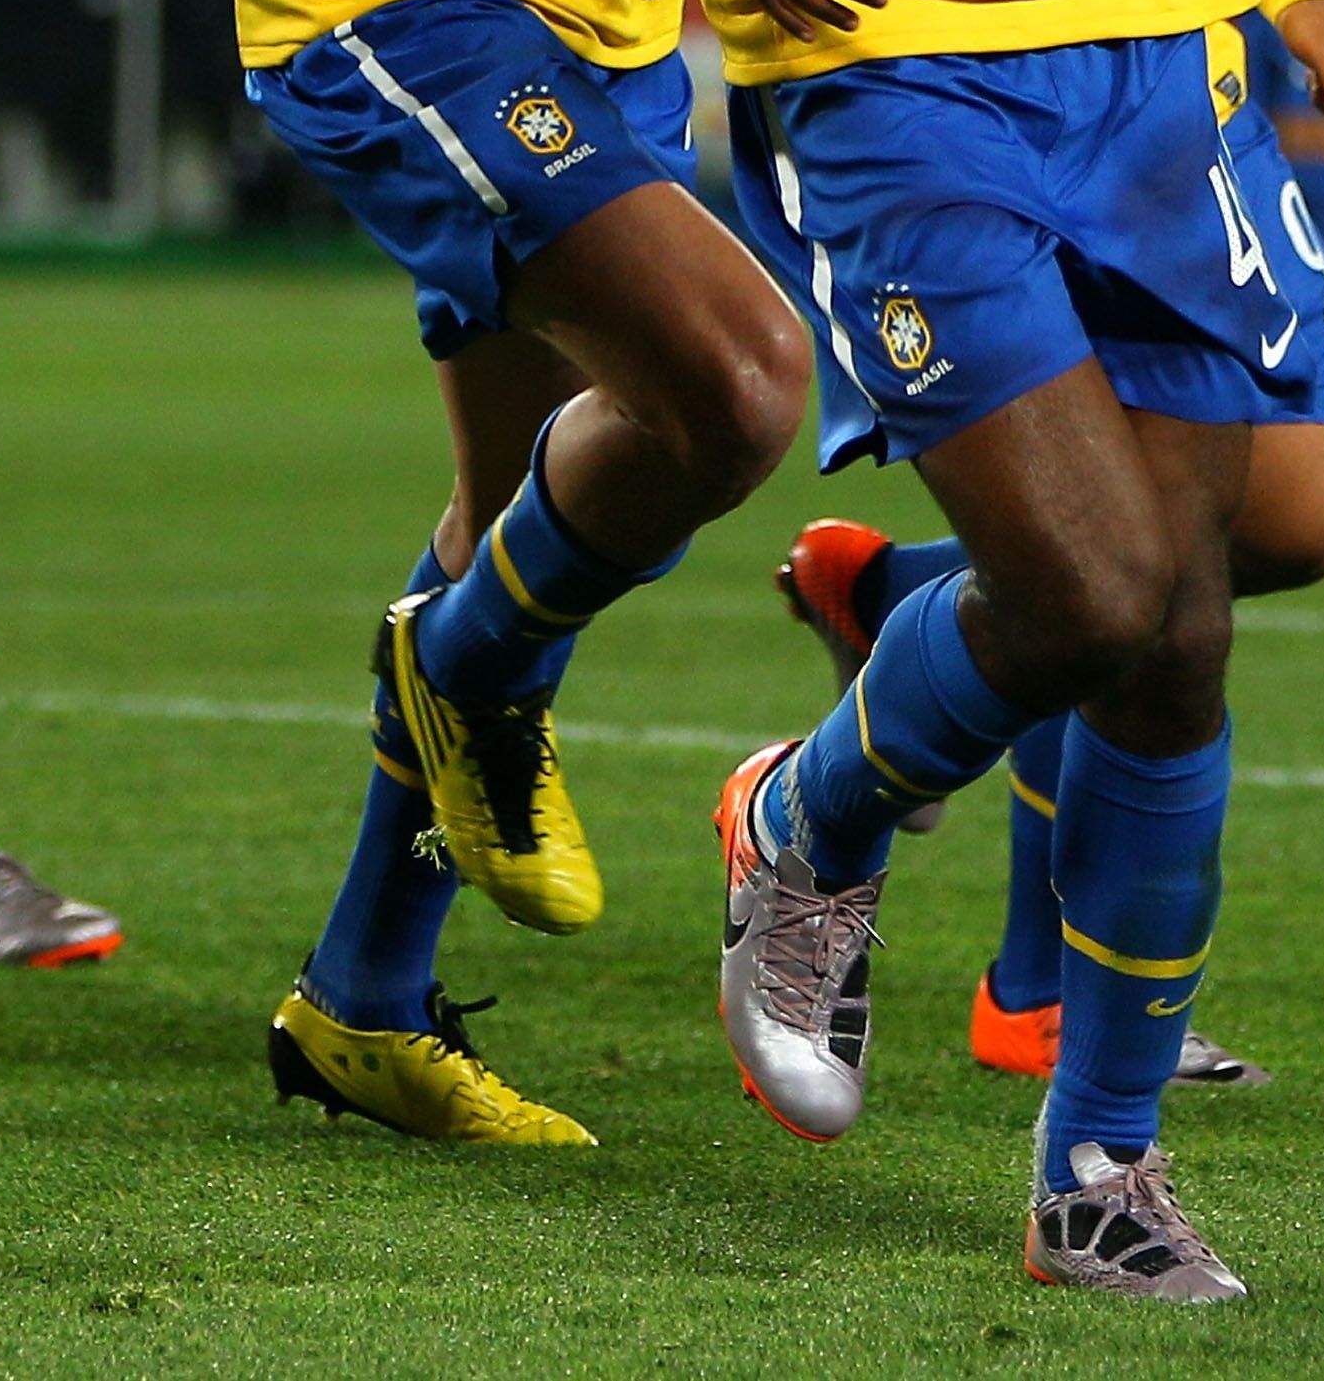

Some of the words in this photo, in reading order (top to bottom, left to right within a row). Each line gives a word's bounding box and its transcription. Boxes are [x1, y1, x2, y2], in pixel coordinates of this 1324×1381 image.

[543, 143, 597, 178] BRASIL
[1208, 154, 1277, 296] 4
[906, 358, 955, 396] BRASIL
